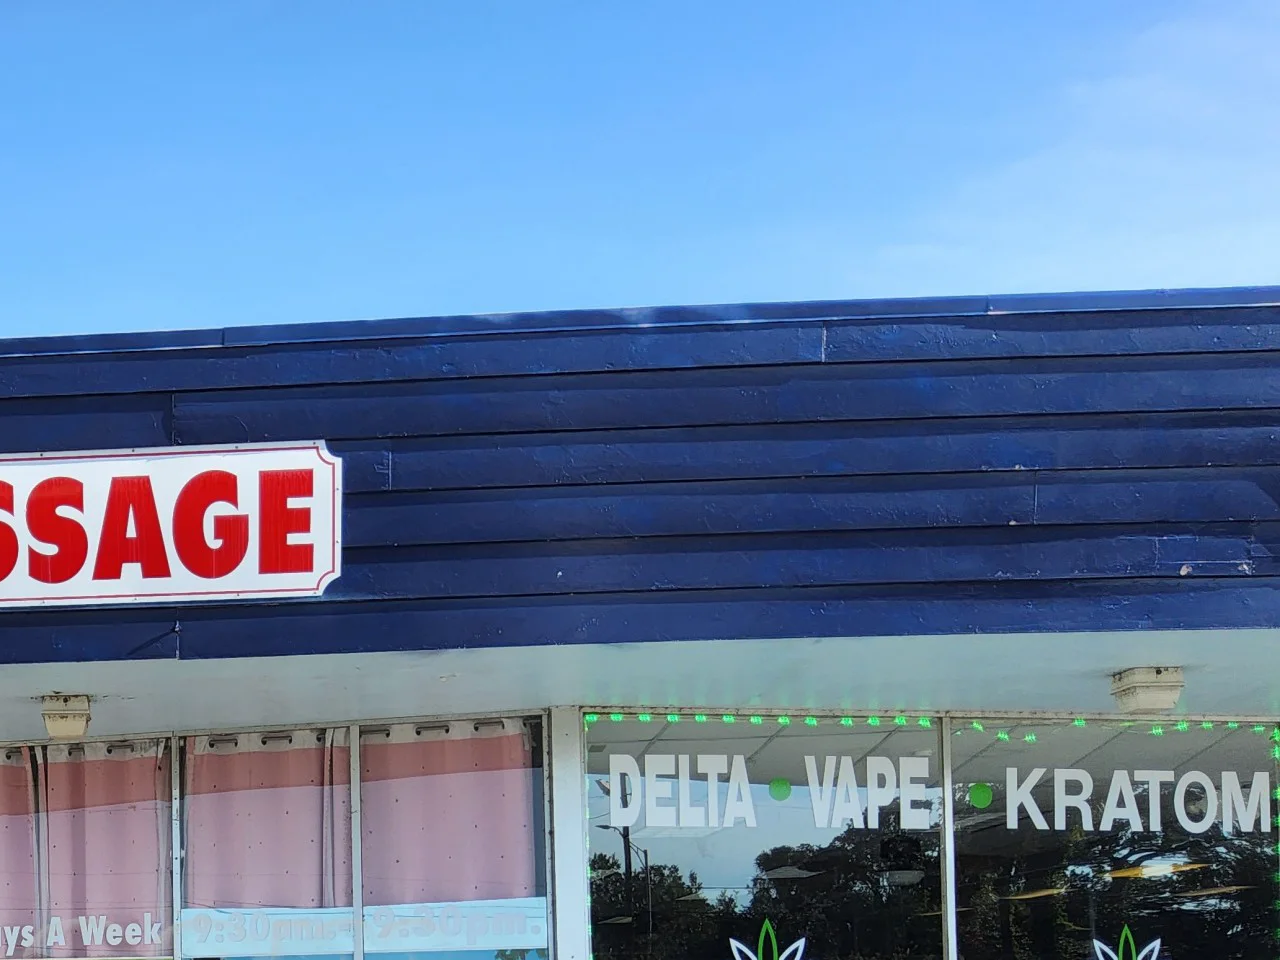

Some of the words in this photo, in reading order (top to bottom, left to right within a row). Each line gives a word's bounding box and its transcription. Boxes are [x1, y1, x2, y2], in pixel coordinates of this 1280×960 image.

[609, 753, 757, 828] DELTA
[804, 755, 930, 830] VAPE
[1005, 767, 1271, 833] KRATOM
[47, 916, 65, 946] A
[79, 912, 162, 947] Week
